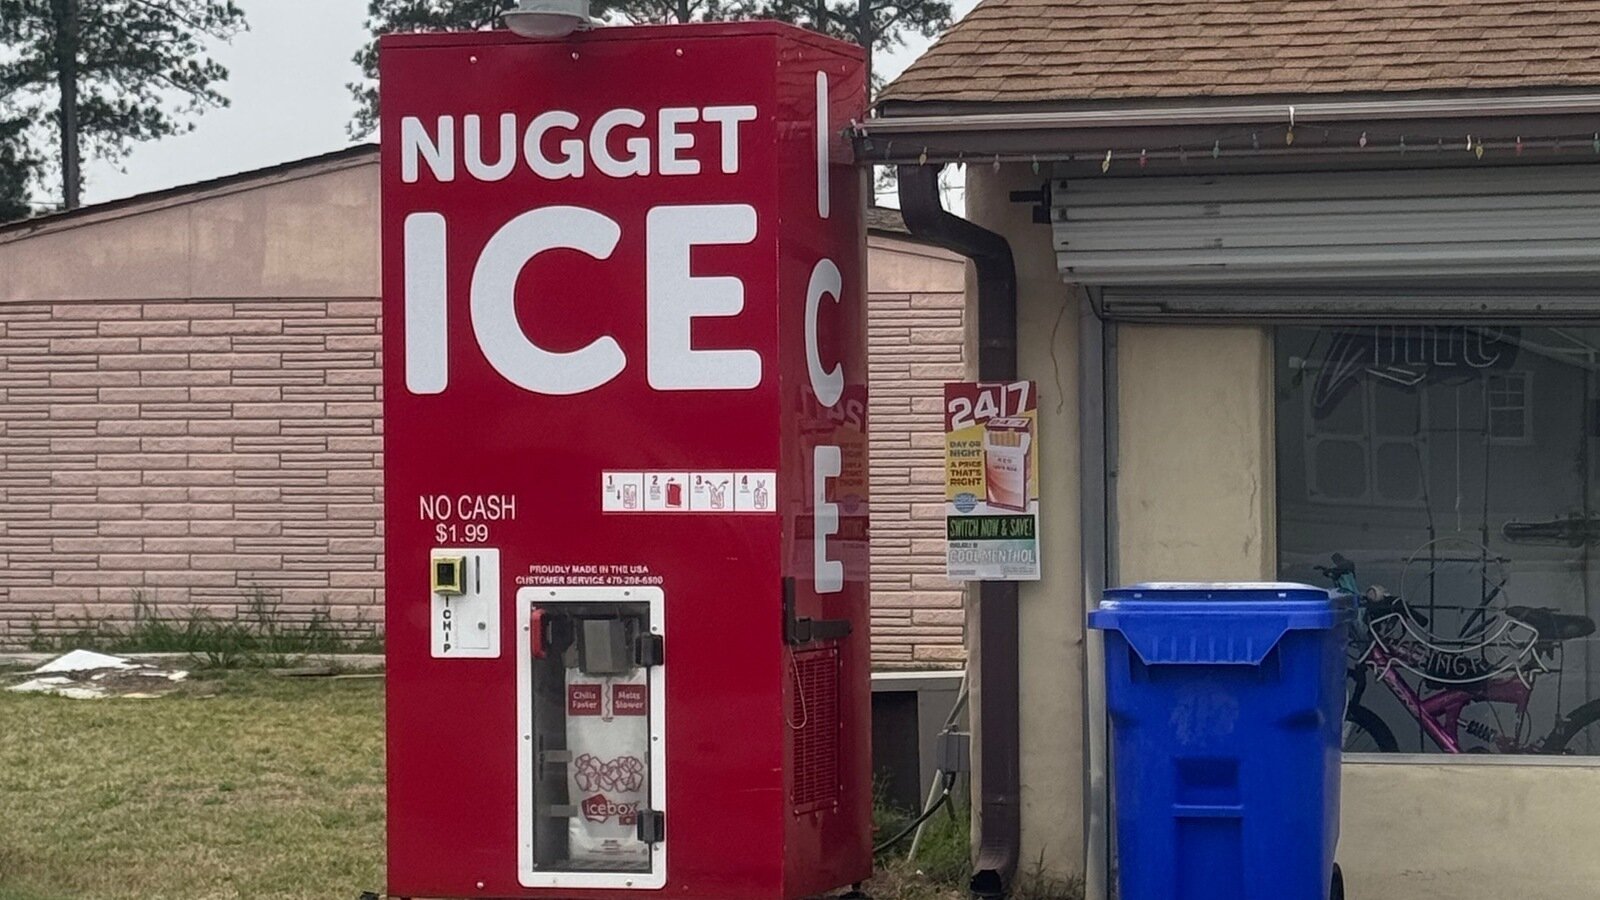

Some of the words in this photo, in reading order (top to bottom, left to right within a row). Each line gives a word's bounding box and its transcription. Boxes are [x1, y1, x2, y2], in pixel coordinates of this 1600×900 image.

[401, 105, 757, 183] NUGGET
[403, 203, 762, 395] ICE
[805, 70, 845, 594] ICE
[948, 380, 1030, 431] 24/7
[949, 449, 982, 457] NIGHT
[950, 469, 982, 477] THAT'S
[608, 475, 613, 485] 1
[652, 475, 658, 485] 2
[695, 475, 702, 485] 3
[741, 475, 748, 485] 4
[949, 477, 982, 486] RIGHT
[420, 495, 452, 521] NO
[457, 494, 516, 520] CASH
[949, 519, 979, 537] SWITCH
[980, 519, 1000, 537] NOW
[1001, 518, 1009, 537] &
[1009, 517, 1033, 537] SAVE!
[435, 523, 489, 544] $1.99
[949, 549, 979, 563] COOL
[980, 548, 1035, 564] MENTHOL
[529, 564, 571, 574] PROUDLY
[571, 564, 598, 574] MADE
[599, 564, 609, 574] IN
[610, 564, 628, 574] THE
[629, 564, 649, 574] USA
[515, 575, 565, 585] CUSTOMER
[566, 575, 605, 585] SERVICE
[572, 691, 596, 700] Chills
[617, 691, 641, 700] Melts
[572, 700, 598, 709] Faster
[615, 700, 644, 709] Slower
[586, 799, 637, 816] icebox
